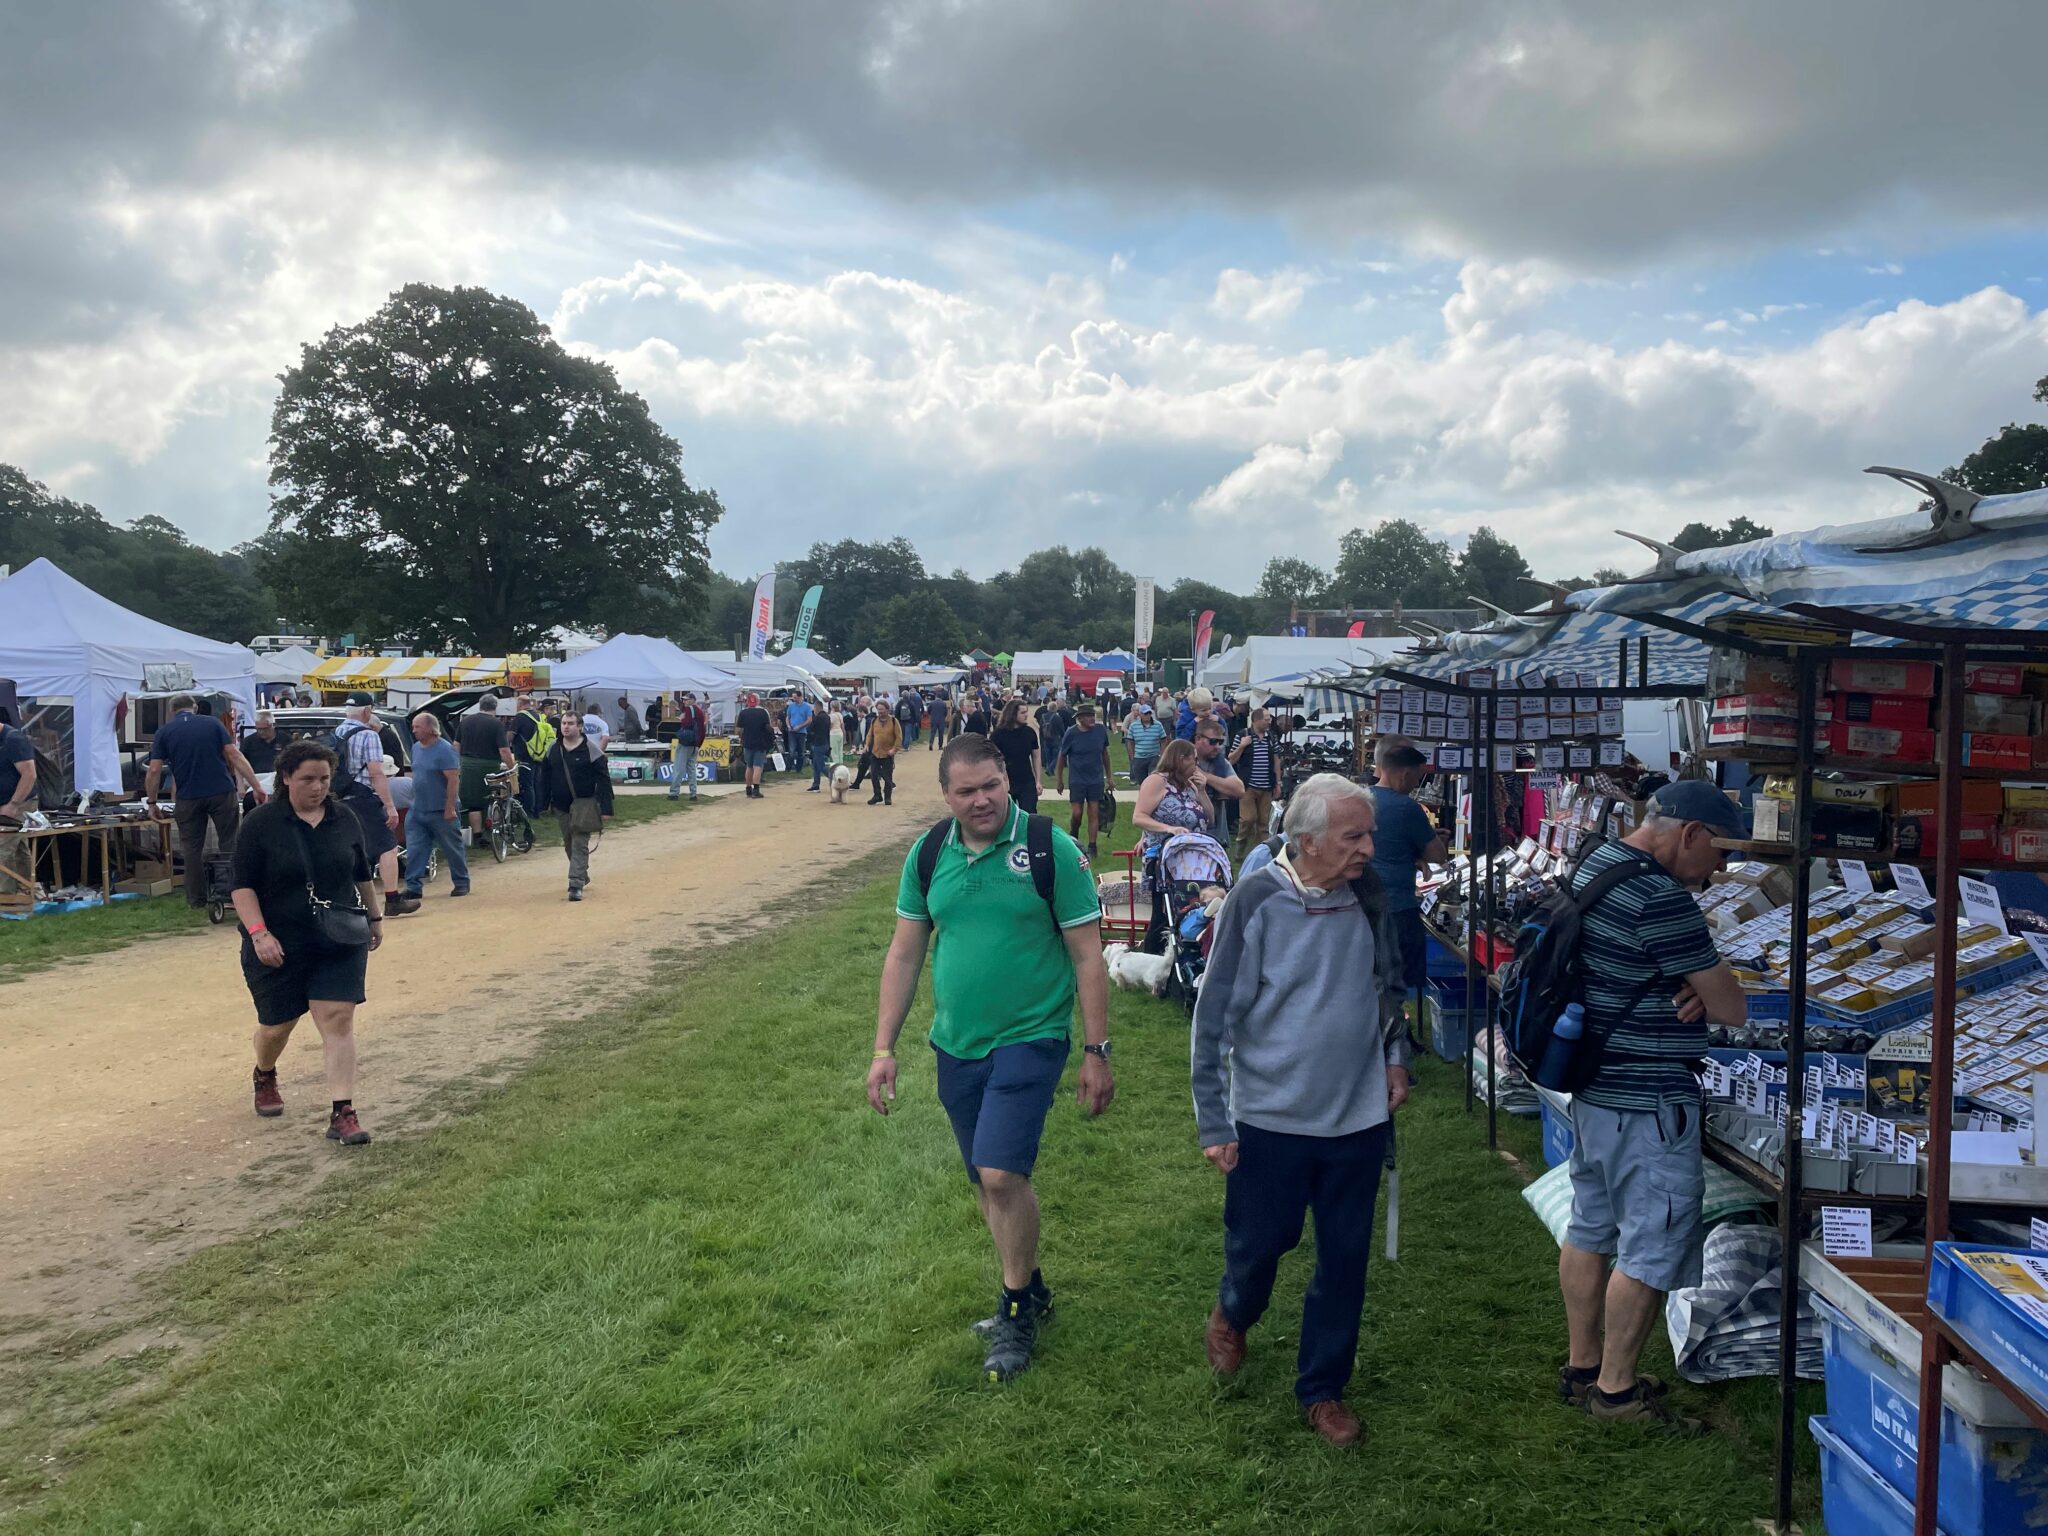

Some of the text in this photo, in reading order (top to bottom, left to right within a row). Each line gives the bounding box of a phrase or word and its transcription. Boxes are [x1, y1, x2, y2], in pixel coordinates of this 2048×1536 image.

[753, 597, 770, 659] AccuSpark
[796, 607, 813, 641] TUDOR
[317, 678, 358, 690] VINTAGE
[1530, 781, 1556, 789] PUMPS
[1967, 881, 1989, 895] MASTER
[1889, 1035, 1928, 1048] Lockheed
[1874, 1405, 1919, 1453] DO IT AL
